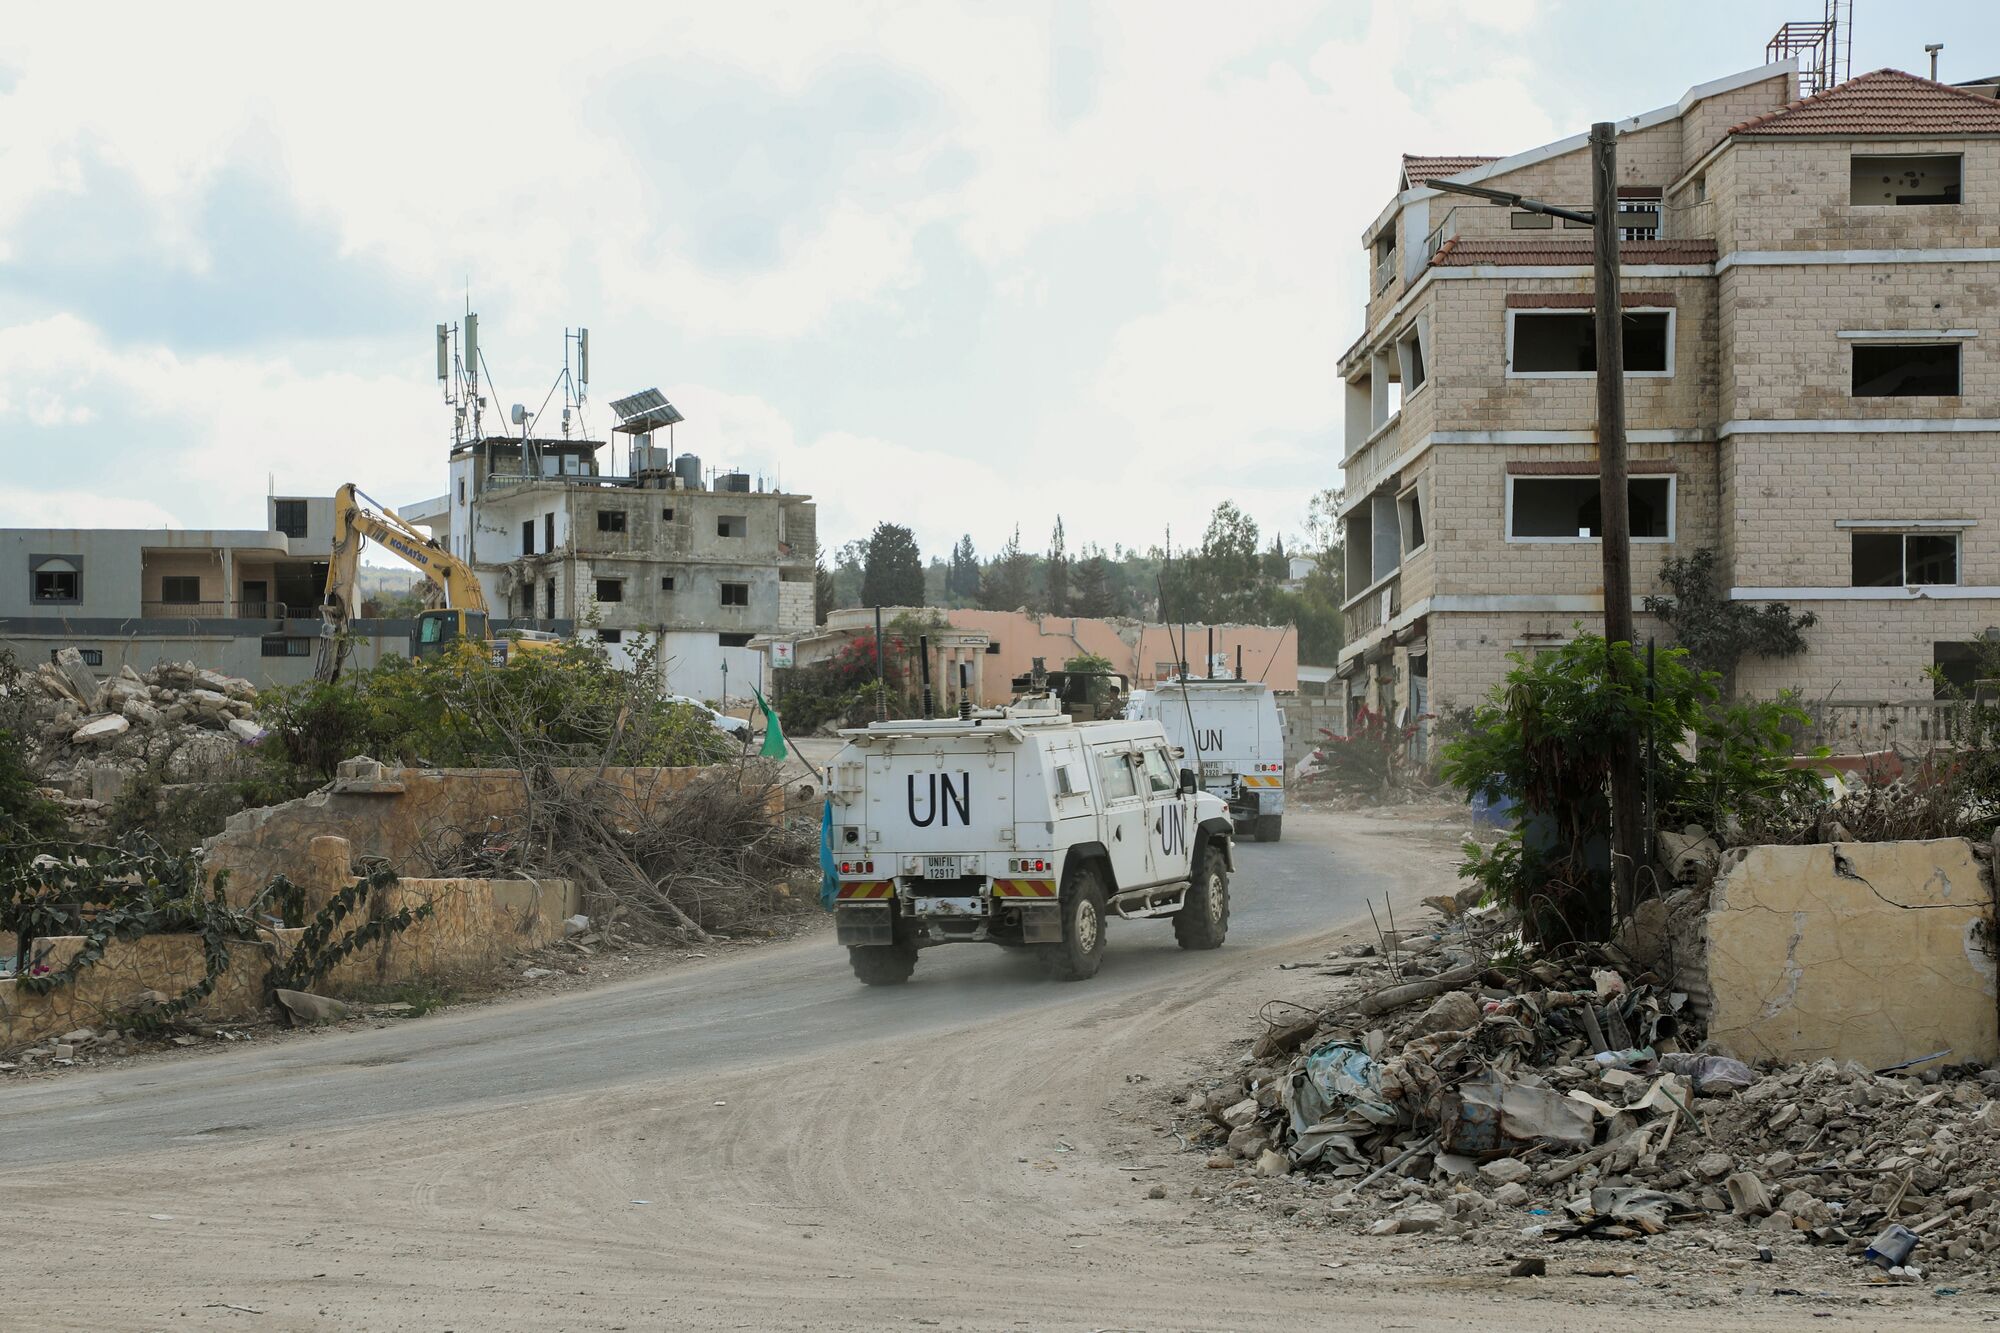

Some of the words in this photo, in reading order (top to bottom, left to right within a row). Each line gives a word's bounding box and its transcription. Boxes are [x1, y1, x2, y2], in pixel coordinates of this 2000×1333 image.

[390, 538, 428, 564] KOMATSU
[492, 655, 505, 663] 290
[1198, 729, 1223, 751] UN
[1203, 769, 1220, 777] 2920
[908, 772, 970, 827] UN
[1162, 804, 1185, 856] UN
[928, 856, 955, 867] UNIFIL
[930, 868, 955, 879] 12917
